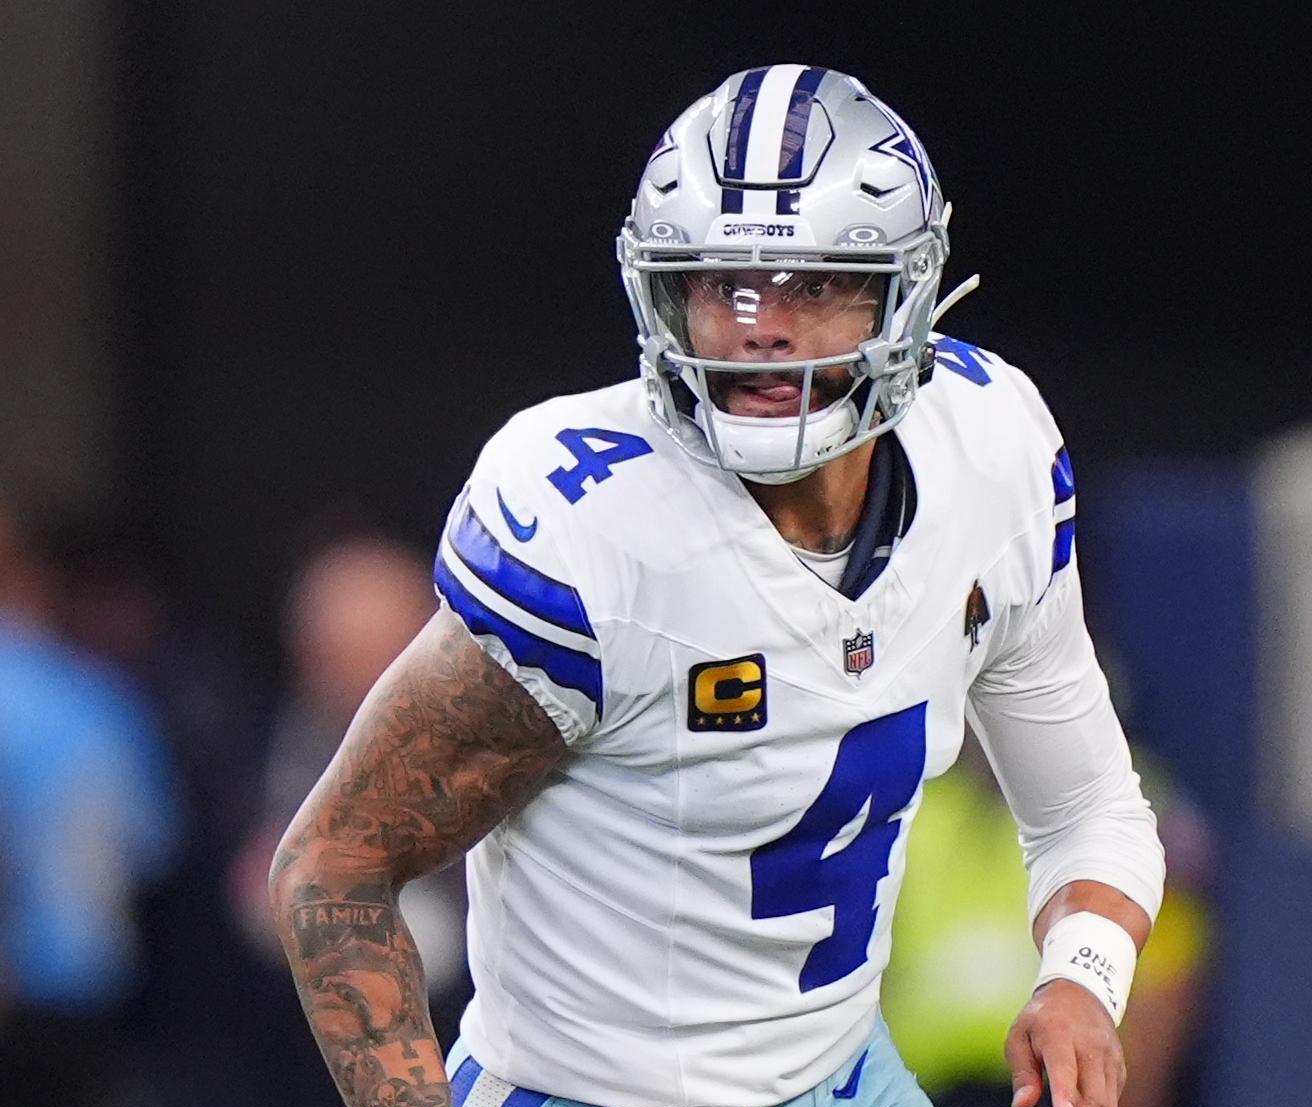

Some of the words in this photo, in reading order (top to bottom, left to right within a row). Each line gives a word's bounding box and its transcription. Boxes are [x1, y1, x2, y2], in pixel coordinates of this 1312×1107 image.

[724, 223, 795, 238] COWBOYS
[546, 427, 655, 506] 4
[849, 650, 872, 670] NFL
[694, 661, 762, 714] C
[751, 700, 929, 994] 4
[299, 907, 384, 930] FAMILY
[1078, 946, 1118, 976] ONE
